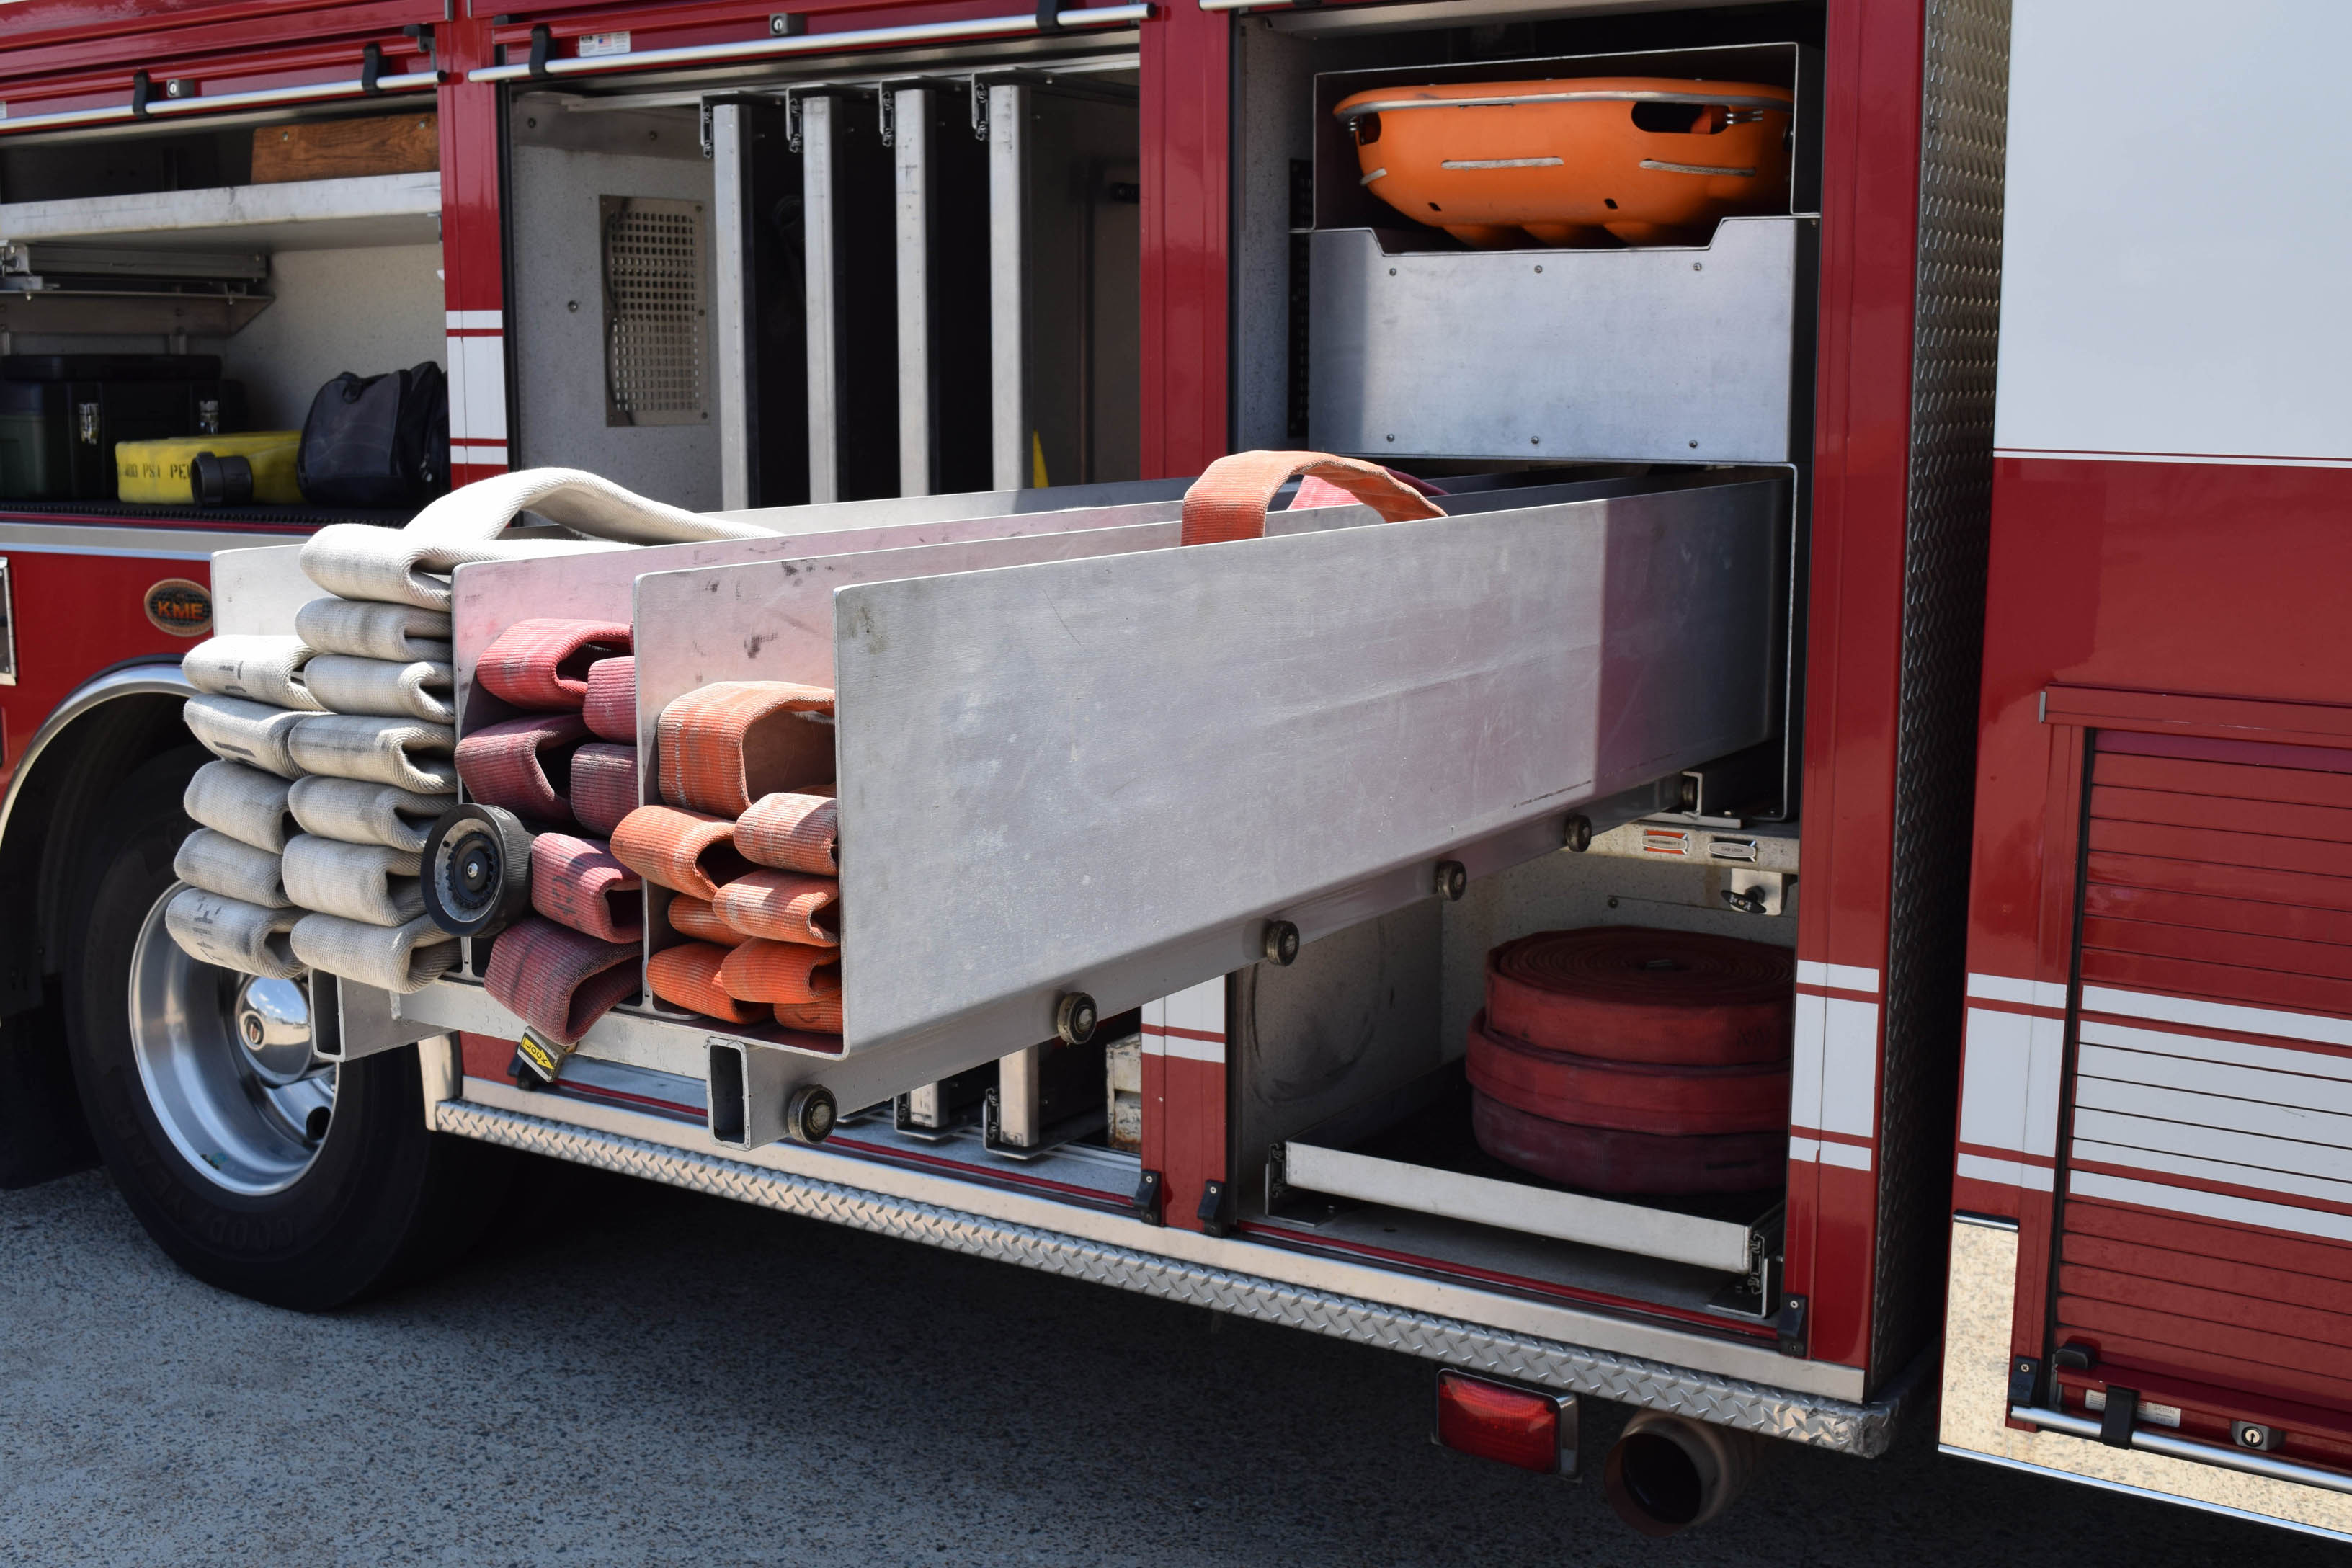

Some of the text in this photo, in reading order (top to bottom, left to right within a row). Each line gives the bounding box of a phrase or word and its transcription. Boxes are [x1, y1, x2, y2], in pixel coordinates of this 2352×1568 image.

[143, 463, 160, 478] PSI
[157, 600, 205, 619] KME
[525, 1043, 548, 1064] LOCK
